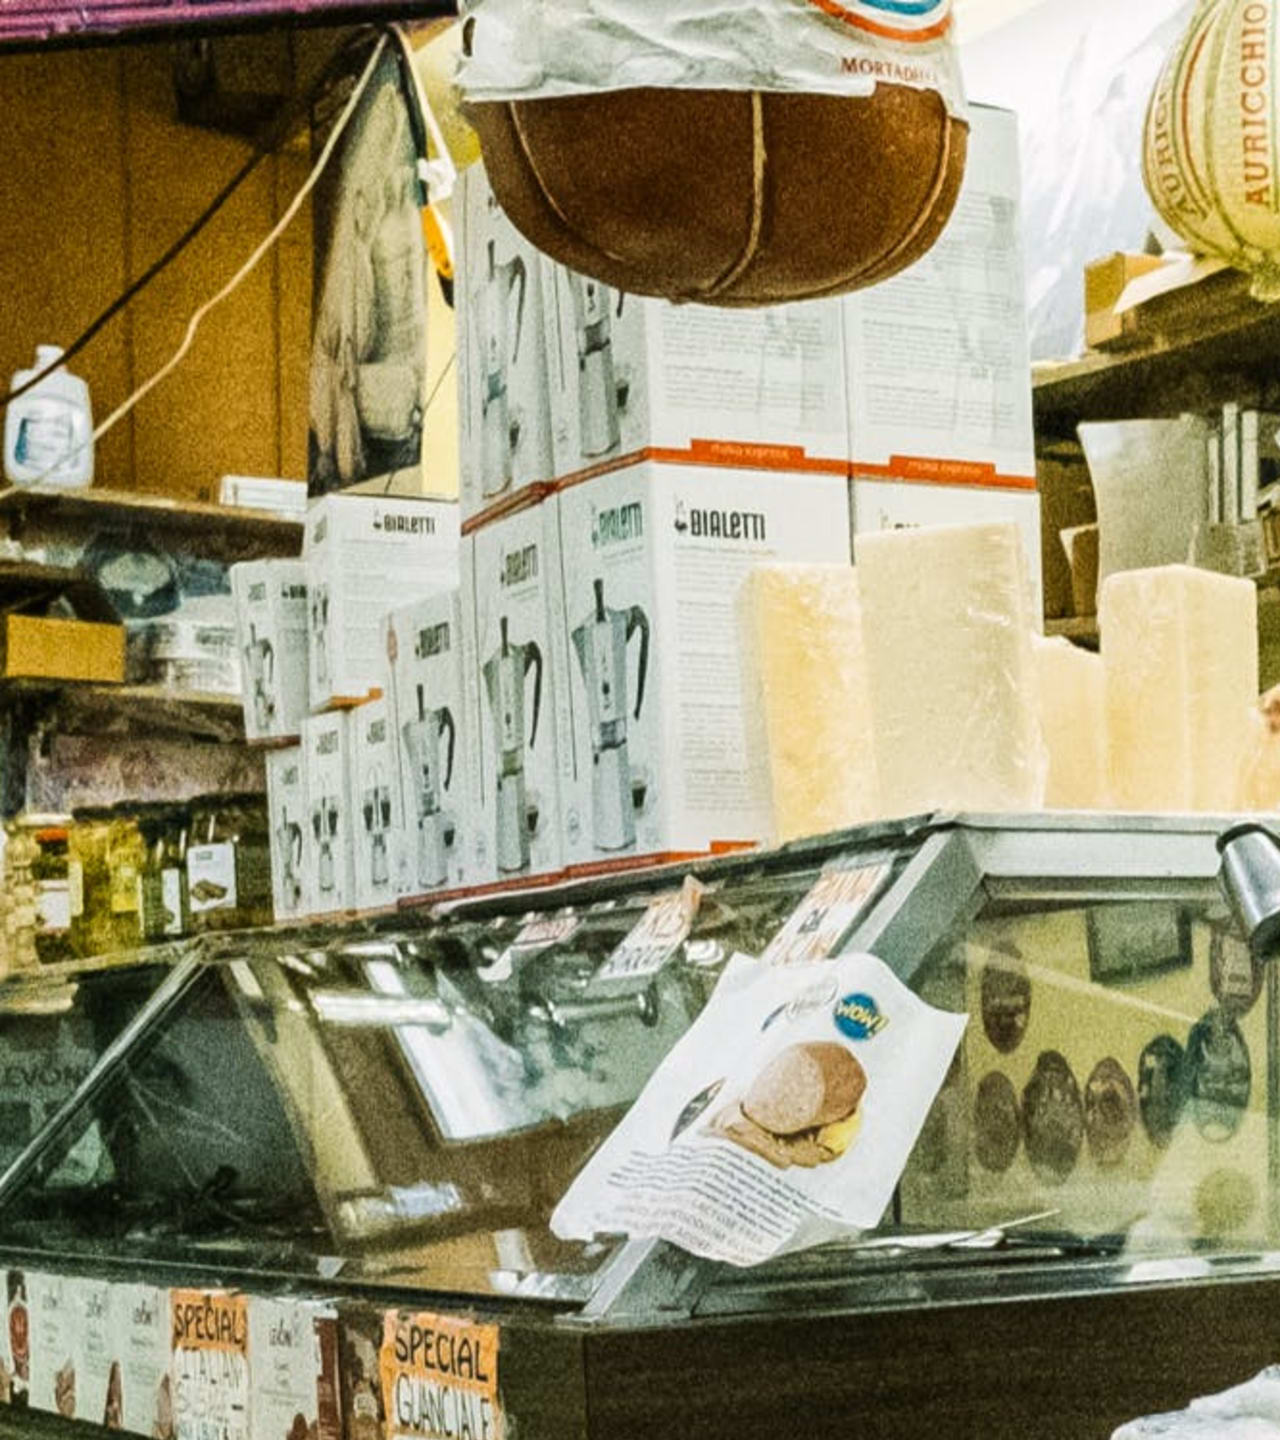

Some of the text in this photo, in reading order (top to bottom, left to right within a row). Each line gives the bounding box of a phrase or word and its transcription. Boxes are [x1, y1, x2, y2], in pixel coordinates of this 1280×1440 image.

[1240, 3, 1271, 206] AURICCHIO
[690, 509, 766, 541] BIALETTI
[174, 1303, 243, 1345] SPECIAL
[395, 1324, 489, 1382] SPECIAL
